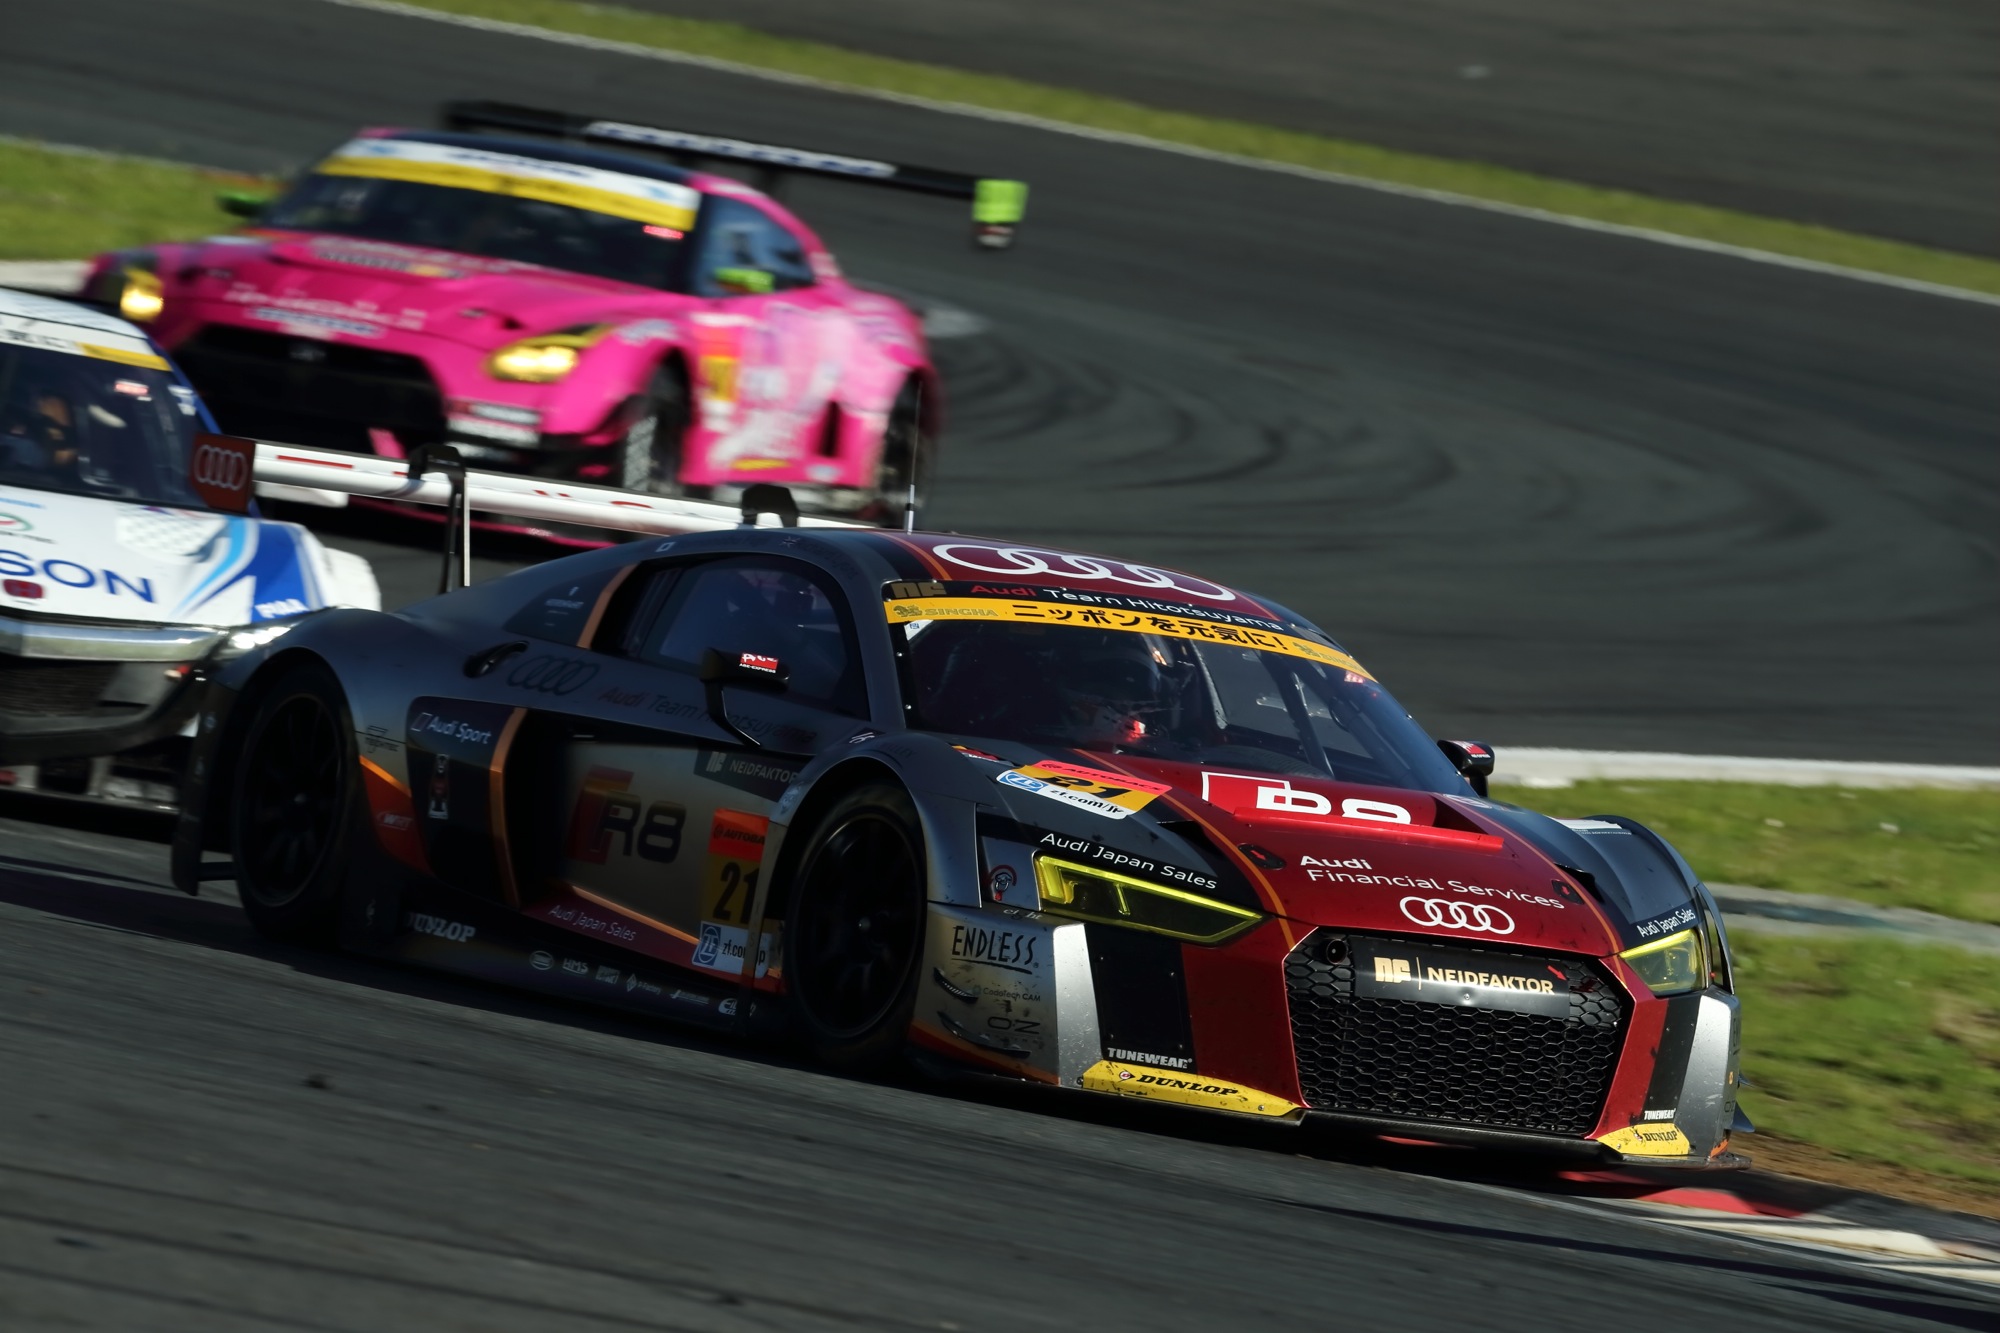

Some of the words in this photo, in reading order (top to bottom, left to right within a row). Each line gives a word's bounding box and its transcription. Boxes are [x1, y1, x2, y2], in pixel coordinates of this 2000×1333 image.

[925, 608, 999, 617] SINGHA
[970, 585, 1037, 597] Audi
[1043, 588, 1122, 606] Team
[1126, 598, 1284, 631] Hitotsuyama
[649, 694, 698, 719] Team
[427, 716, 459, 736] Audi
[455, 723, 492, 744] Sport
[1036, 776, 1131, 798] 21
[1040, 833, 1090, 853] Audi
[1093, 846, 1155, 872] Japan
[1160, 865, 1218, 889] Sales
[1300, 855, 1372, 870] Audi
[713, 862, 759, 925] 21
[1307, 869, 1444, 891] Financial
[1448, 880, 1565, 909] Services
[548, 904, 574, 921] Audi
[574, 911, 606, 930] Japan
[607, 922, 637, 941] Sales
[1636, 921, 1661, 938] Audi
[1654, 916, 1681, 934] Japan
[1675, 908, 1696, 924] Sales
[952, 925, 1037, 966] ENDLESS
[1427, 966, 1556, 995] NEIDFAKTOR
[1137, 1074, 1239, 1096] DUNLOP
[1643, 1130, 1679, 1143] DUNLOP
